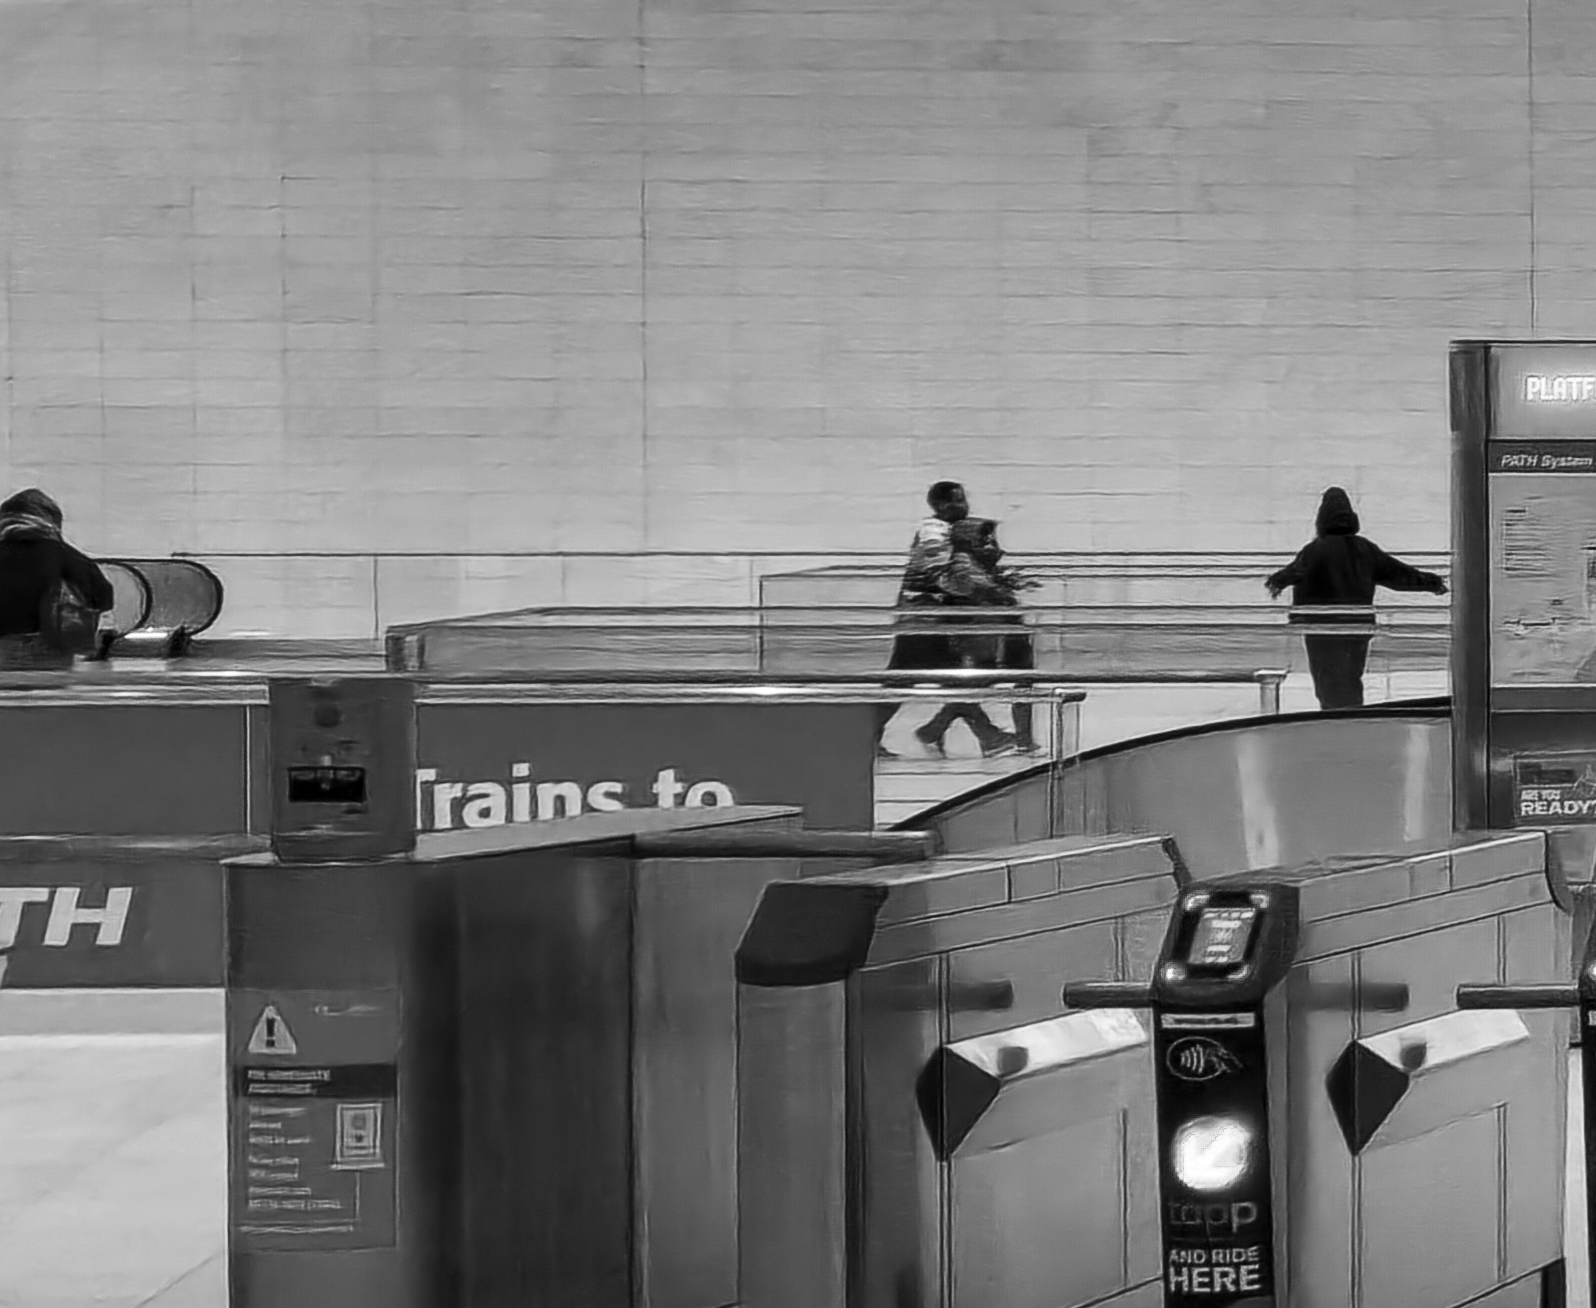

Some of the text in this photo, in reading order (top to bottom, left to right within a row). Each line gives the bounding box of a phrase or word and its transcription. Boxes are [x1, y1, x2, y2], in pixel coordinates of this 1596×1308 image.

[1501, 455, 1538, 467] PATH
[1541, 455, 1593, 469] System
[652, 768, 736, 808] to
[1169, 1246, 1260, 1264] AND RIDE
[1169, 1264, 1262, 1293] HERE
